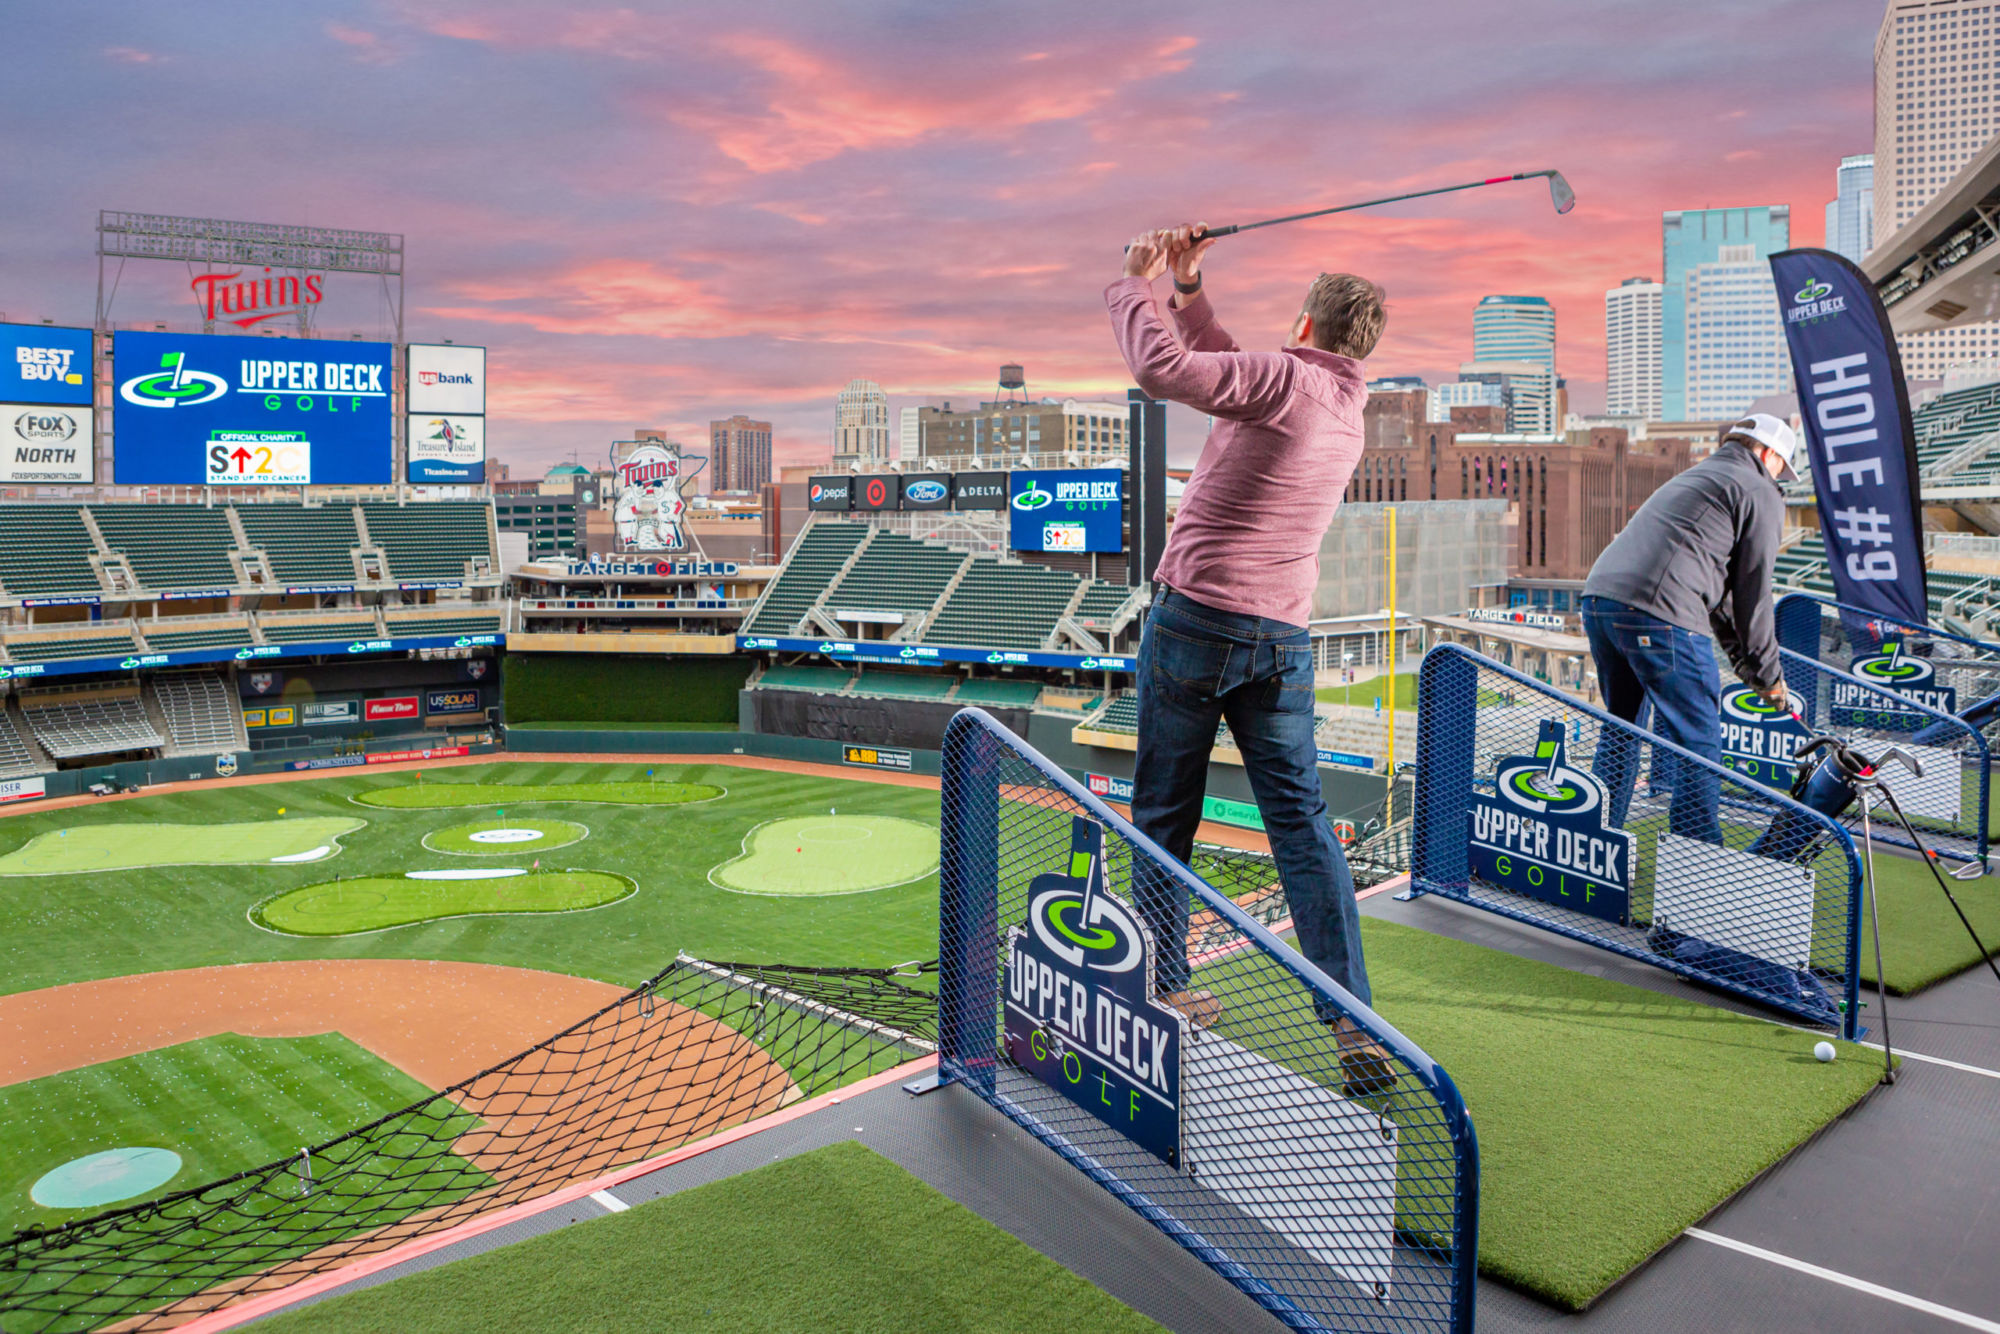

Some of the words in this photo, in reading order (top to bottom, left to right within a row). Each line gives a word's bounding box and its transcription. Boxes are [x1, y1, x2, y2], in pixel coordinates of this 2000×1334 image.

[192, 267, 322, 320] Twins
[1788, 302, 1818, 320] UPPER
[1819, 296, 1844, 312] DECK
[17, 347, 74, 365] BEST
[21, 363, 69, 381] BUY
[241, 359, 318, 389] UPPER
[324, 363, 383, 391] DECK
[264, 394, 361, 412] GOLF
[28, 416, 63, 431] FOX
[1809, 351, 1885, 493] HOLE
[220, 433, 258, 441] OFFICIAL
[416, 441, 447, 451] Treasure
[454, 441, 476, 451] Island
[15, 447, 76, 463] NORTH
[11, 472, 82, 480] FOXSPORTSNORTH.COM
[619, 458, 678, 488] Twins
[823, 487, 848, 500] pepsi
[912, 484, 938, 499] Ford
[969, 486, 1002, 496] DELTA
[1057, 482, 1089, 498] UPPER
[1091, 482, 1117, 498] DECK
[1065, 501, 1109, 511] GOLF
[1834, 506, 1898, 582] #9
[568, 562, 653, 575] TARGET
[675, 562, 740, 576] FIELD
[1468, 608, 1512, 620] TARGET
[1526, 613, 1561, 626] FIELD
[1835, 684, 1893, 709] UPPER
[1900, 688, 1950, 714] DECK
[1852, 711, 1930, 728] GOLF
[1720, 722, 1764, 755] PPER
[1474, 804, 1548, 860] UPPER
[1556, 828, 1621, 883] DECK
[1496, 856, 1596, 902] GOLF
[1009, 950, 1087, 1043] UPPER
[1096, 993, 1169, 1093] DECK
[1031, 1030, 1141, 1121] GOLF
